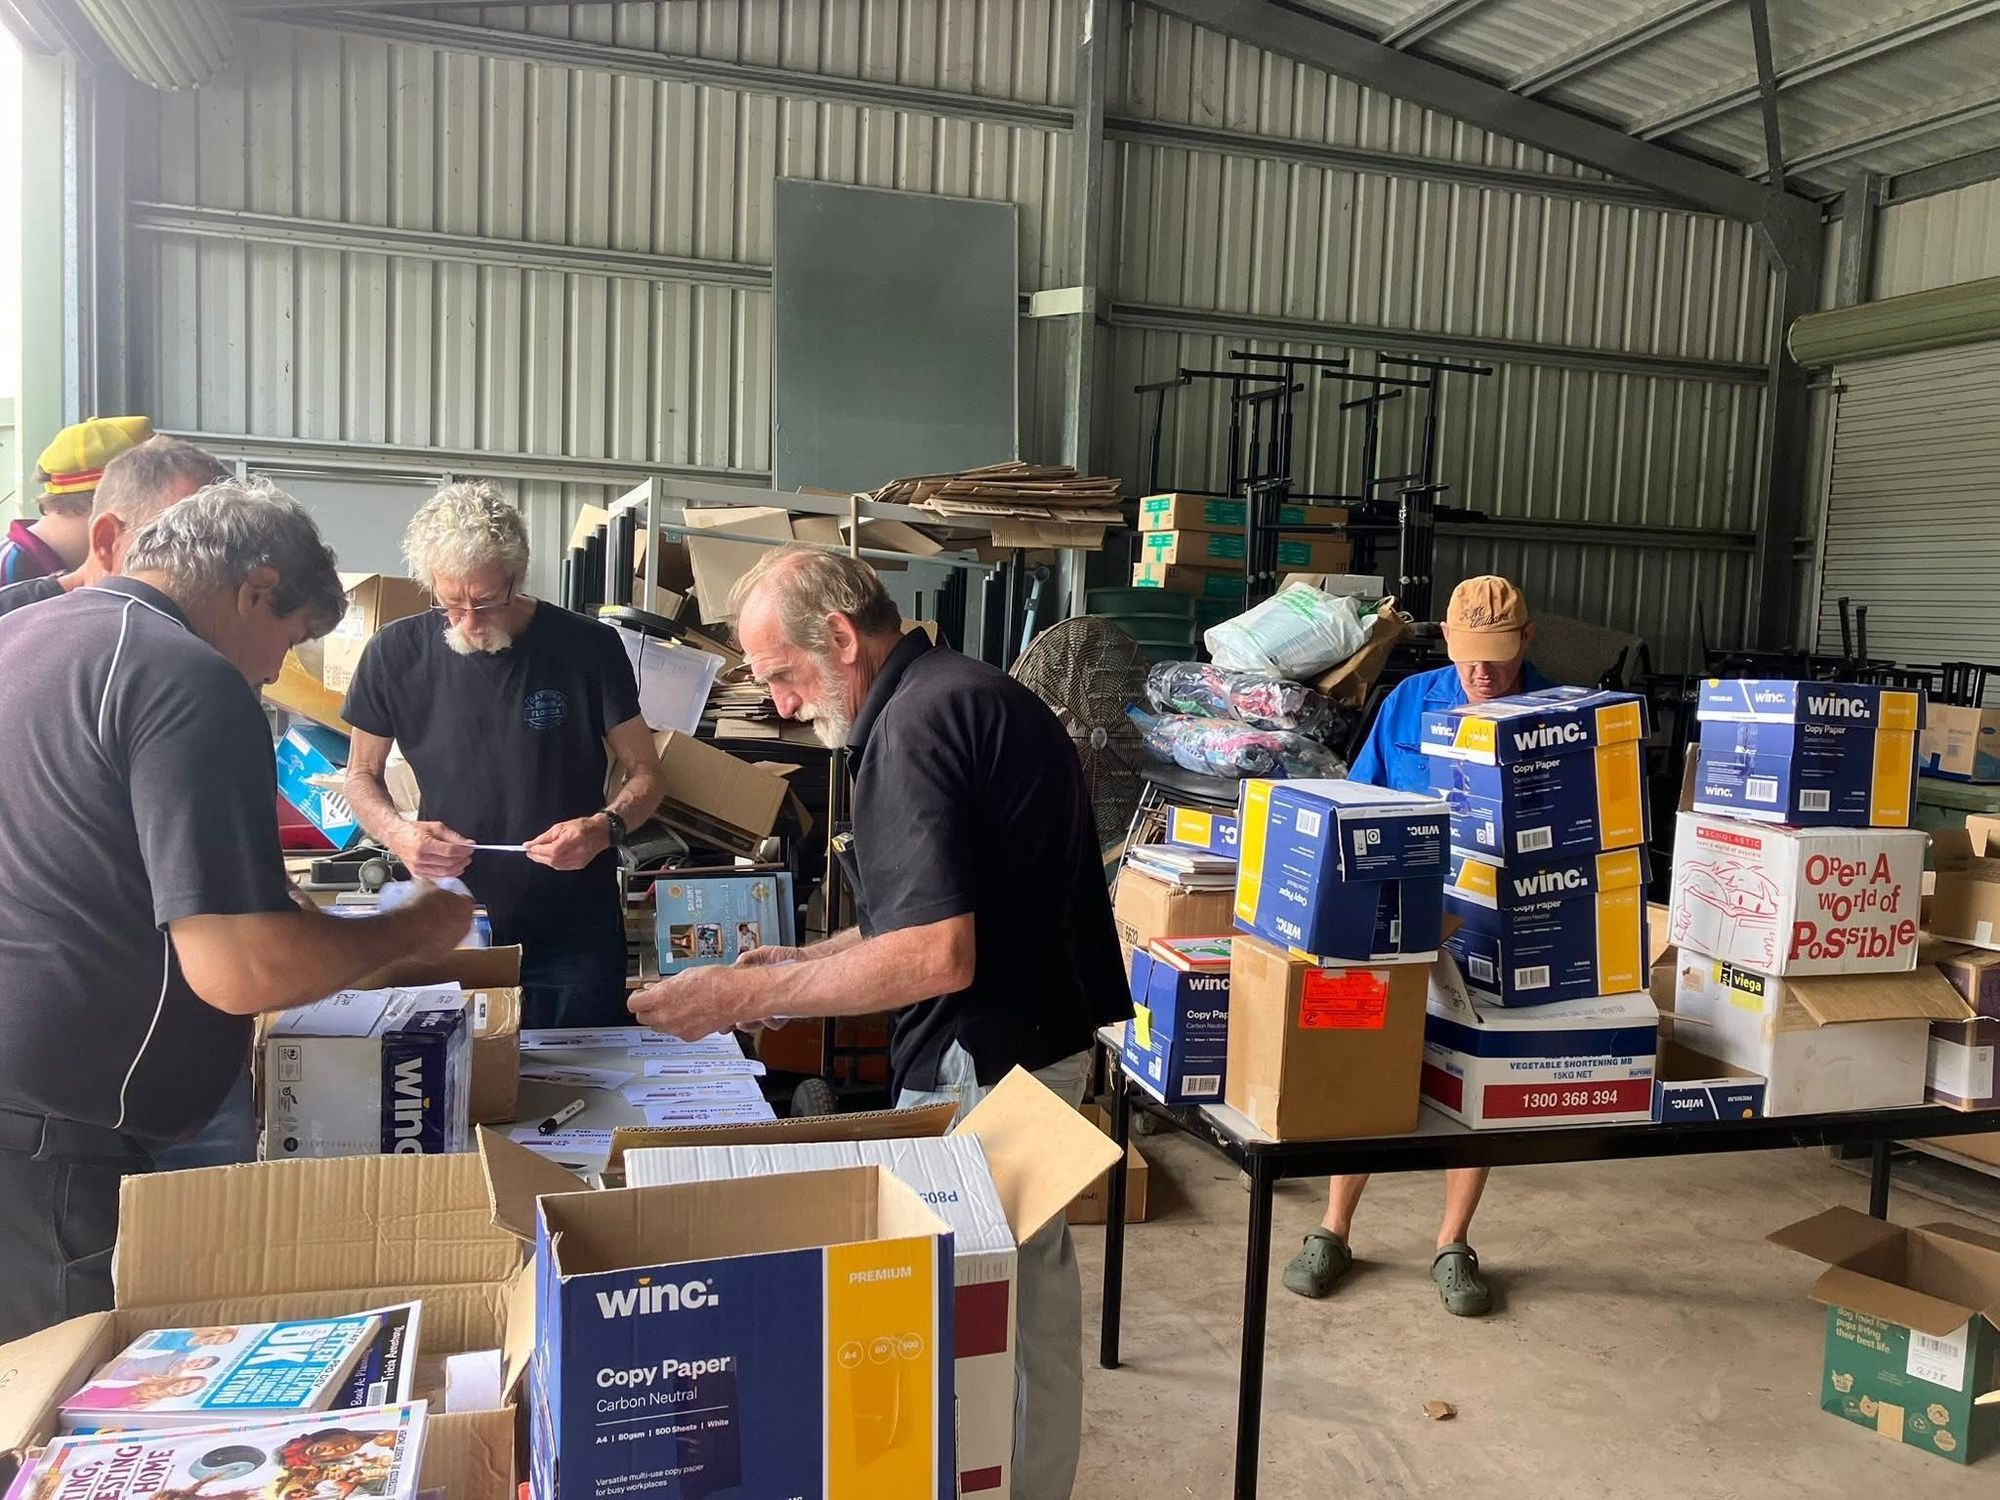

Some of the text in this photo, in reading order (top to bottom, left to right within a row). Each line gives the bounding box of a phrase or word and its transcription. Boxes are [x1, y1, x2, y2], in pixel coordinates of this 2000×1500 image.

[1755, 689, 1786, 703] winc.
[1808, 692, 1870, 718] winc.
[1431, 722, 1455, 737] winc.
[1513, 723, 1588, 751] winc.
[1804, 724, 1846, 735] Copy Paper
[1513, 759, 1561, 774] Copy Paper
[1705, 784, 1733, 798] winc.
[1407, 825, 1440, 839] winc.
[1705, 830, 1761, 849] SCHOLASTIC
[1805, 853, 1892, 887] Open A
[1513, 867, 1588, 897] winc.
[1880, 884, 1901, 913] of
[1276, 917, 1302, 940] winc.
[1189, 975, 1230, 991] winc
[1734, 973, 1762, 992] viega
[1187, 1010, 1229, 1021] Copy Pap
[1510, 1061, 1562, 1070] VEGETABLE
[1563, 1059, 1618, 1069] SHORTENING
[1553, 1070, 1593, 1080] 15KG NET
[394, 1057, 430, 1154] winc
[1523, 1090, 1618, 1108] 1300 368 394
[1671, 1099, 1704, 1111] winc.
[849, 1266, 912, 1284] PREMIUM
[596, 1277, 719, 1319] winc.
[1838, 1307, 1853, 1320] dog
[343, 1326, 366, 1345] STAFF
[1836, 1319, 1881, 1341] pups living
[1836, 1328, 1855, 1341] their
[1856, 1336, 1875, 1348] best
[244, 1323, 337, 1365] OK
[308, 1322, 359, 1361] BETTER
[321, 1359, 341, 1372] PRO
[843, 1351, 857, 1361] A4
[381, 1358, 396, 1382] Tricia
[597, 1356, 731, 1388] Copy Paper
[209, 1368, 260, 1403] BEYOND
[277, 1366, 324, 1401] HELPING
[310, 1374, 329, 1388] DEV
[351, 1385, 364, 1406] Book
[597, 1386, 698, 1413] Carbon Neutral
[596, 1418, 729, 1445] A4 80gsm 500 Sheets White
[133, 1449, 175, 1495] HOME
[596, 1463, 705, 1487] Versatile multi-use copy paper
[595, 1479, 668, 1497] for busy workplaces
